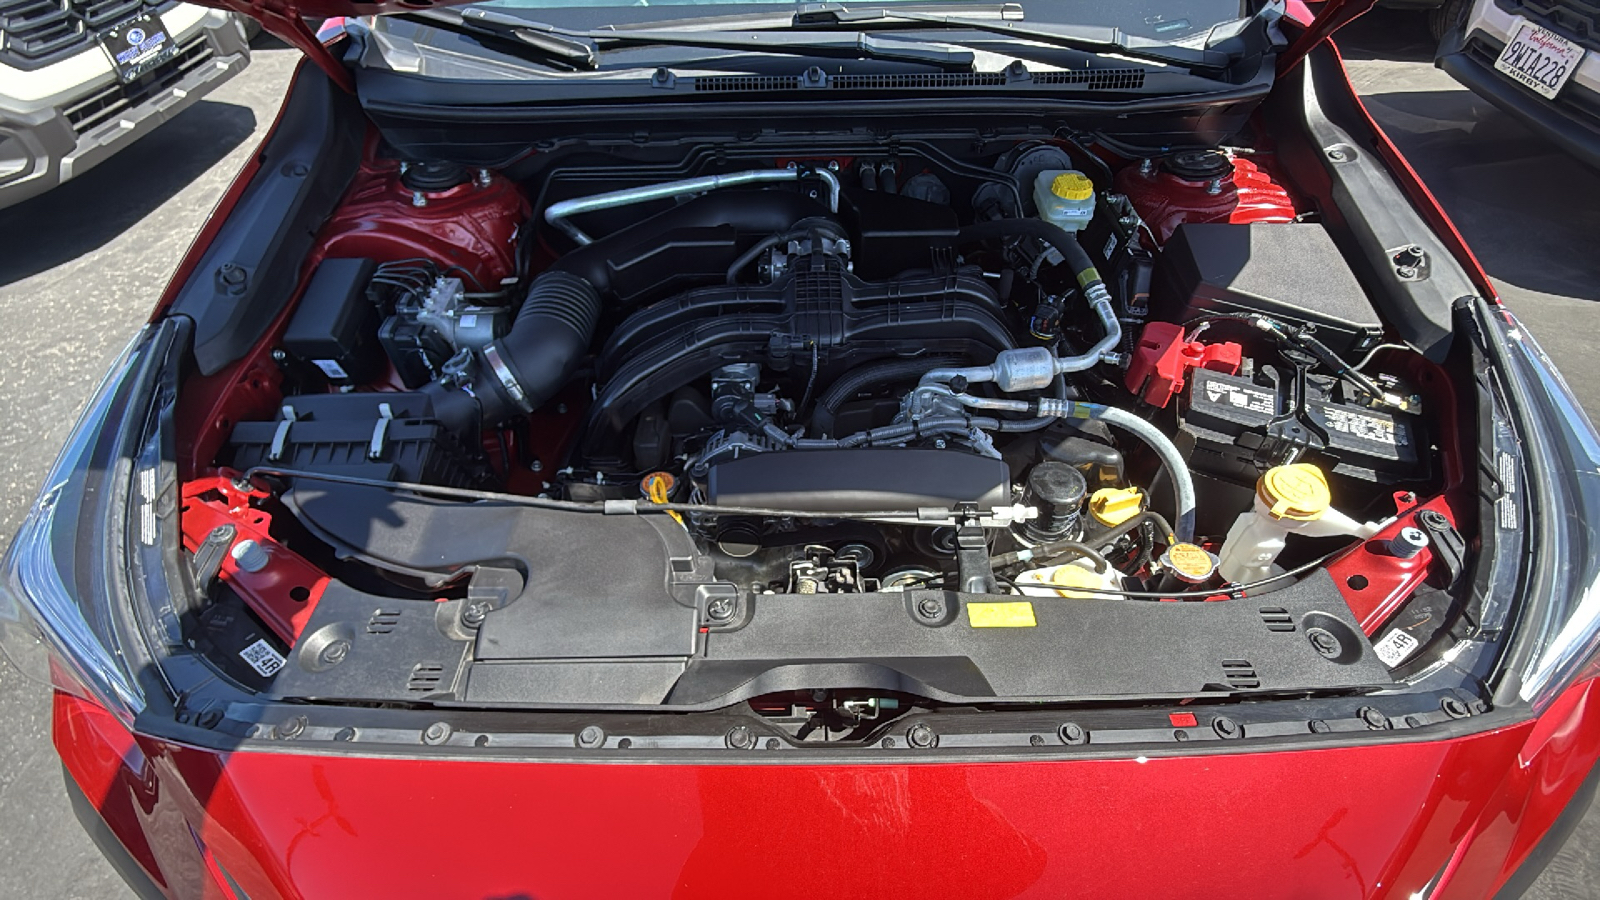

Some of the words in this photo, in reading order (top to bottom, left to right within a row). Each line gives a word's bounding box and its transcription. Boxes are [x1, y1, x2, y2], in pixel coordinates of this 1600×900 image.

[1503, 41, 1566, 89] 9WIA228
[1509, 67, 1541, 88] KIRBY
[1393, 634, 1412, 649] 4R
[261, 658, 281, 673] 4R
